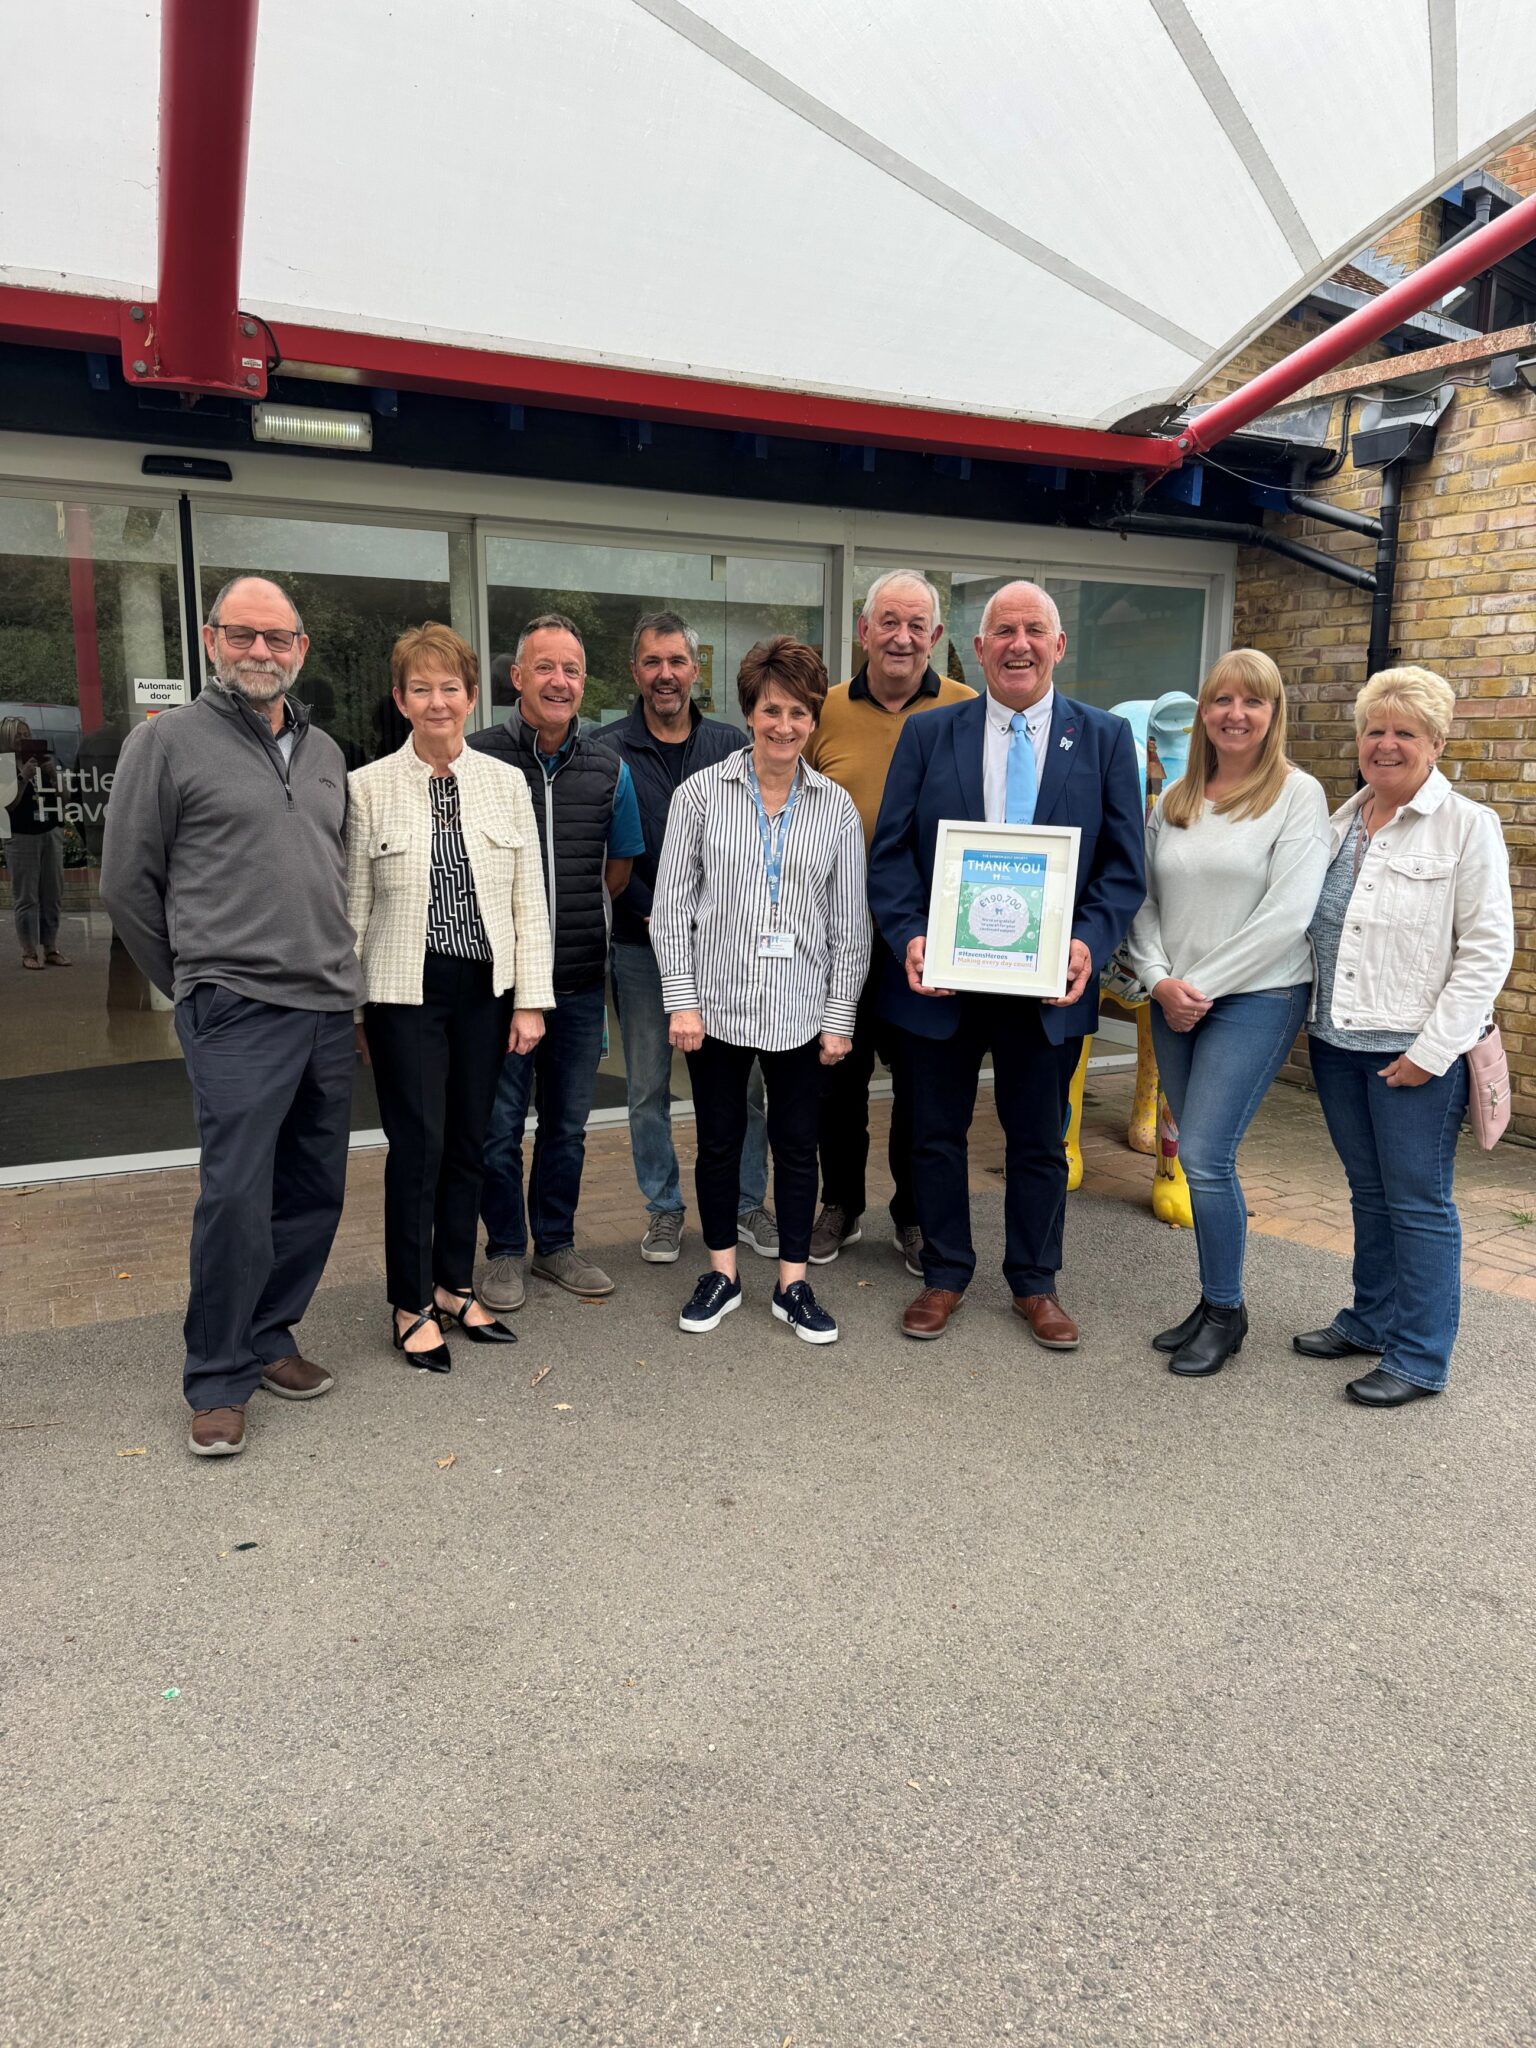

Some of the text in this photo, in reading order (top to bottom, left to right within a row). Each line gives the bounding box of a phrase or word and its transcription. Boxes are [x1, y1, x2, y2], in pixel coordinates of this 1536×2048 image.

[138, 682, 182, 691] Automatic
[150, 692, 171, 700] door
[35, 766, 116, 793] Little
[38, 796, 108, 823] Hav
[968, 859, 1041, 874] THANK YOU
[958, 951, 1008, 960] #HavensHeroes
[957, 957, 981, 965] Making
[1000, 960, 1012, 968] day
